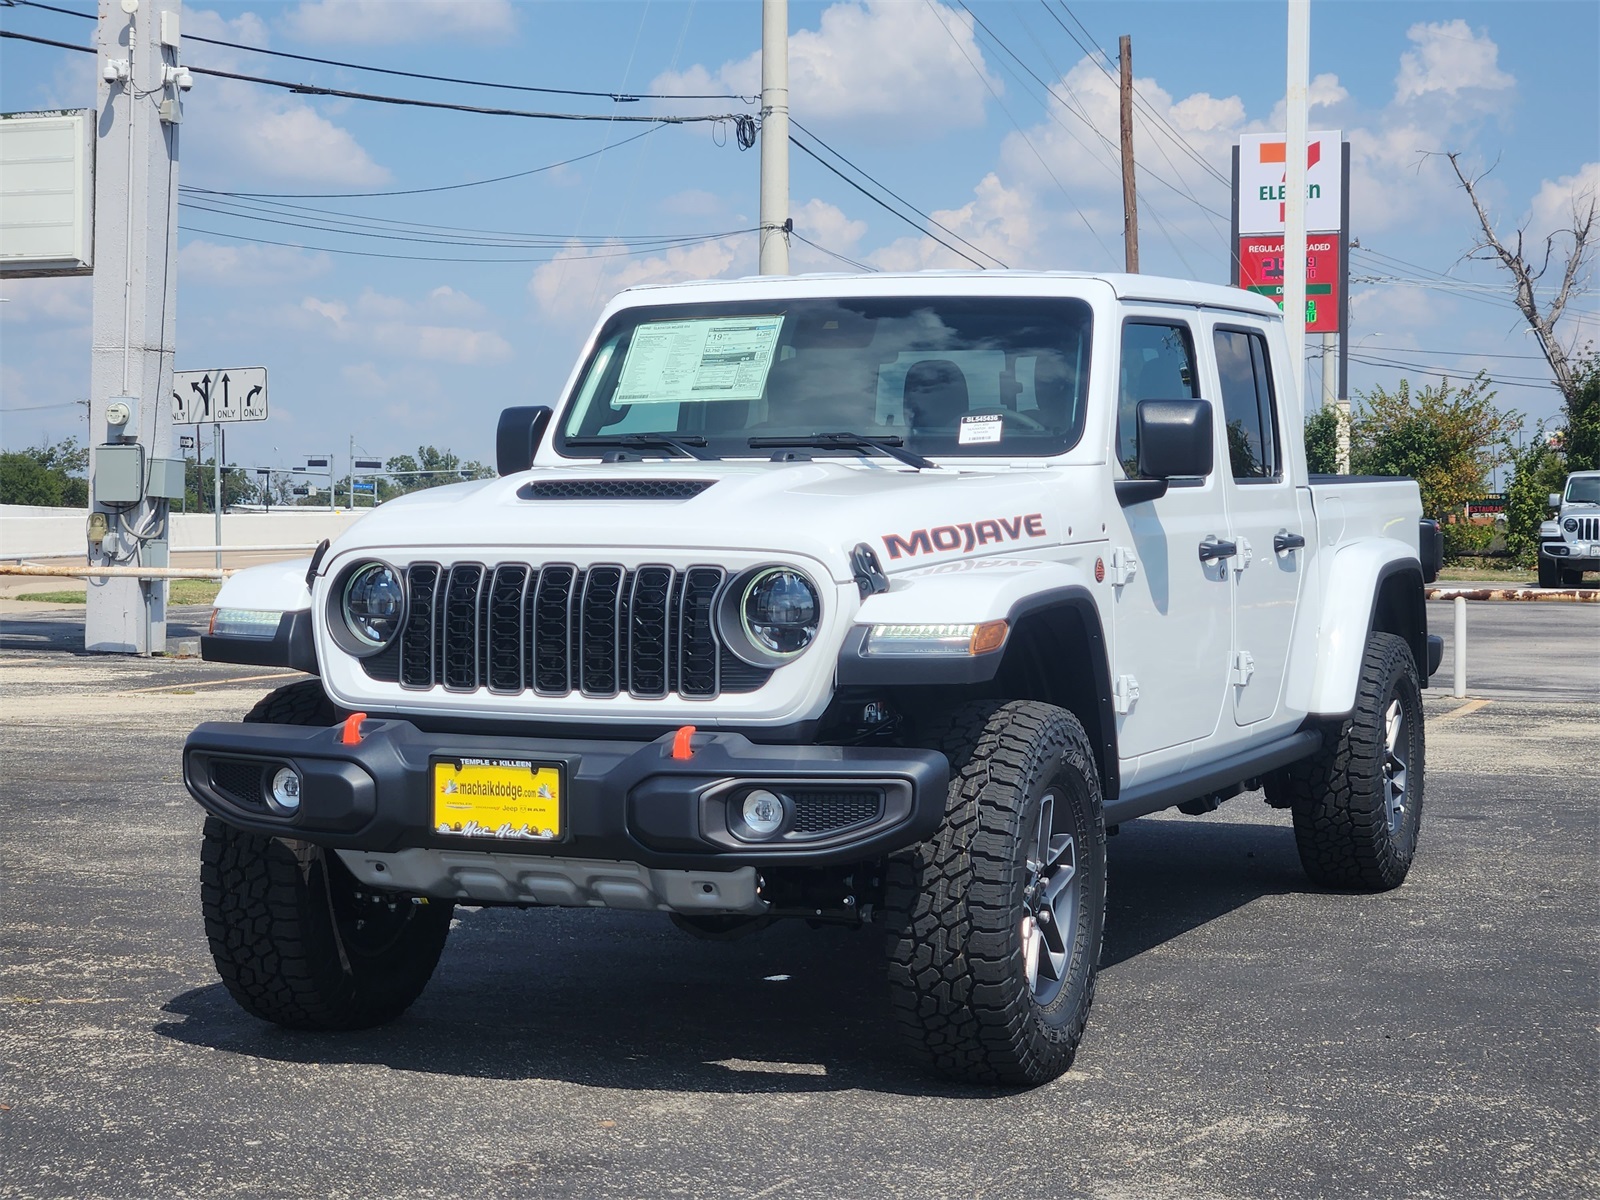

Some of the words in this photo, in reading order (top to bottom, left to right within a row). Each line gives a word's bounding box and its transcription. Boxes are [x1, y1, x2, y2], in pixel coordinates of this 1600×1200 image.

[1259, 183, 1321, 201] ELEn
[172, 412, 186, 421] NLY
[217, 410, 236, 418] ONLY
[243, 408, 264, 417] ONLY
[881, 513, 1047, 560] MOJAVE
[460, 780, 536, 800] machaikdodge.com
[460, 820, 490, 837] Mac
[495, 822, 532, 839] Haik
